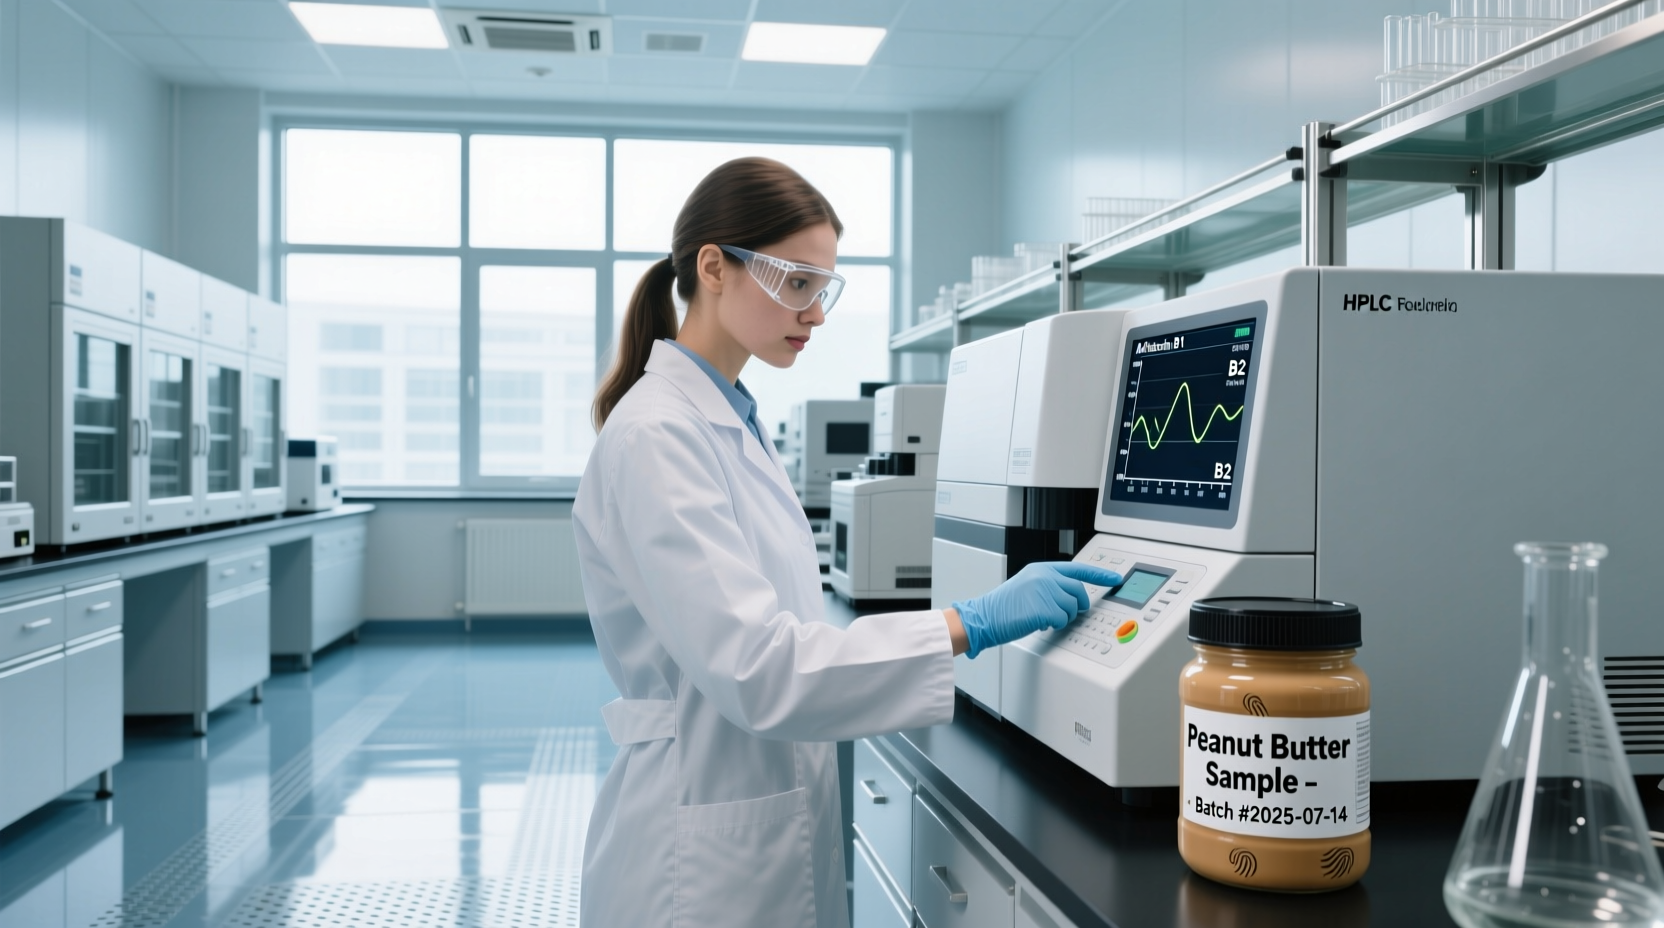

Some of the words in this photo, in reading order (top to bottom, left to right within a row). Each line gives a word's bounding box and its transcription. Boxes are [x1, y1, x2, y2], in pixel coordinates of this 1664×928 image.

[1343, 293, 1392, 312] HPLC
[1173, 336, 1185, 349] B1
[1228, 359, 1246, 377] B2
[1214, 462, 1232, 480] B2
[1187, 722, 1263, 759] Peanut
[1270, 733, 1351, 761] Butter
[1205, 760, 1299, 799] Sample
[1195, 795, 1234, 821] Batch
[1238, 804, 1348, 826] #2025-07-14
